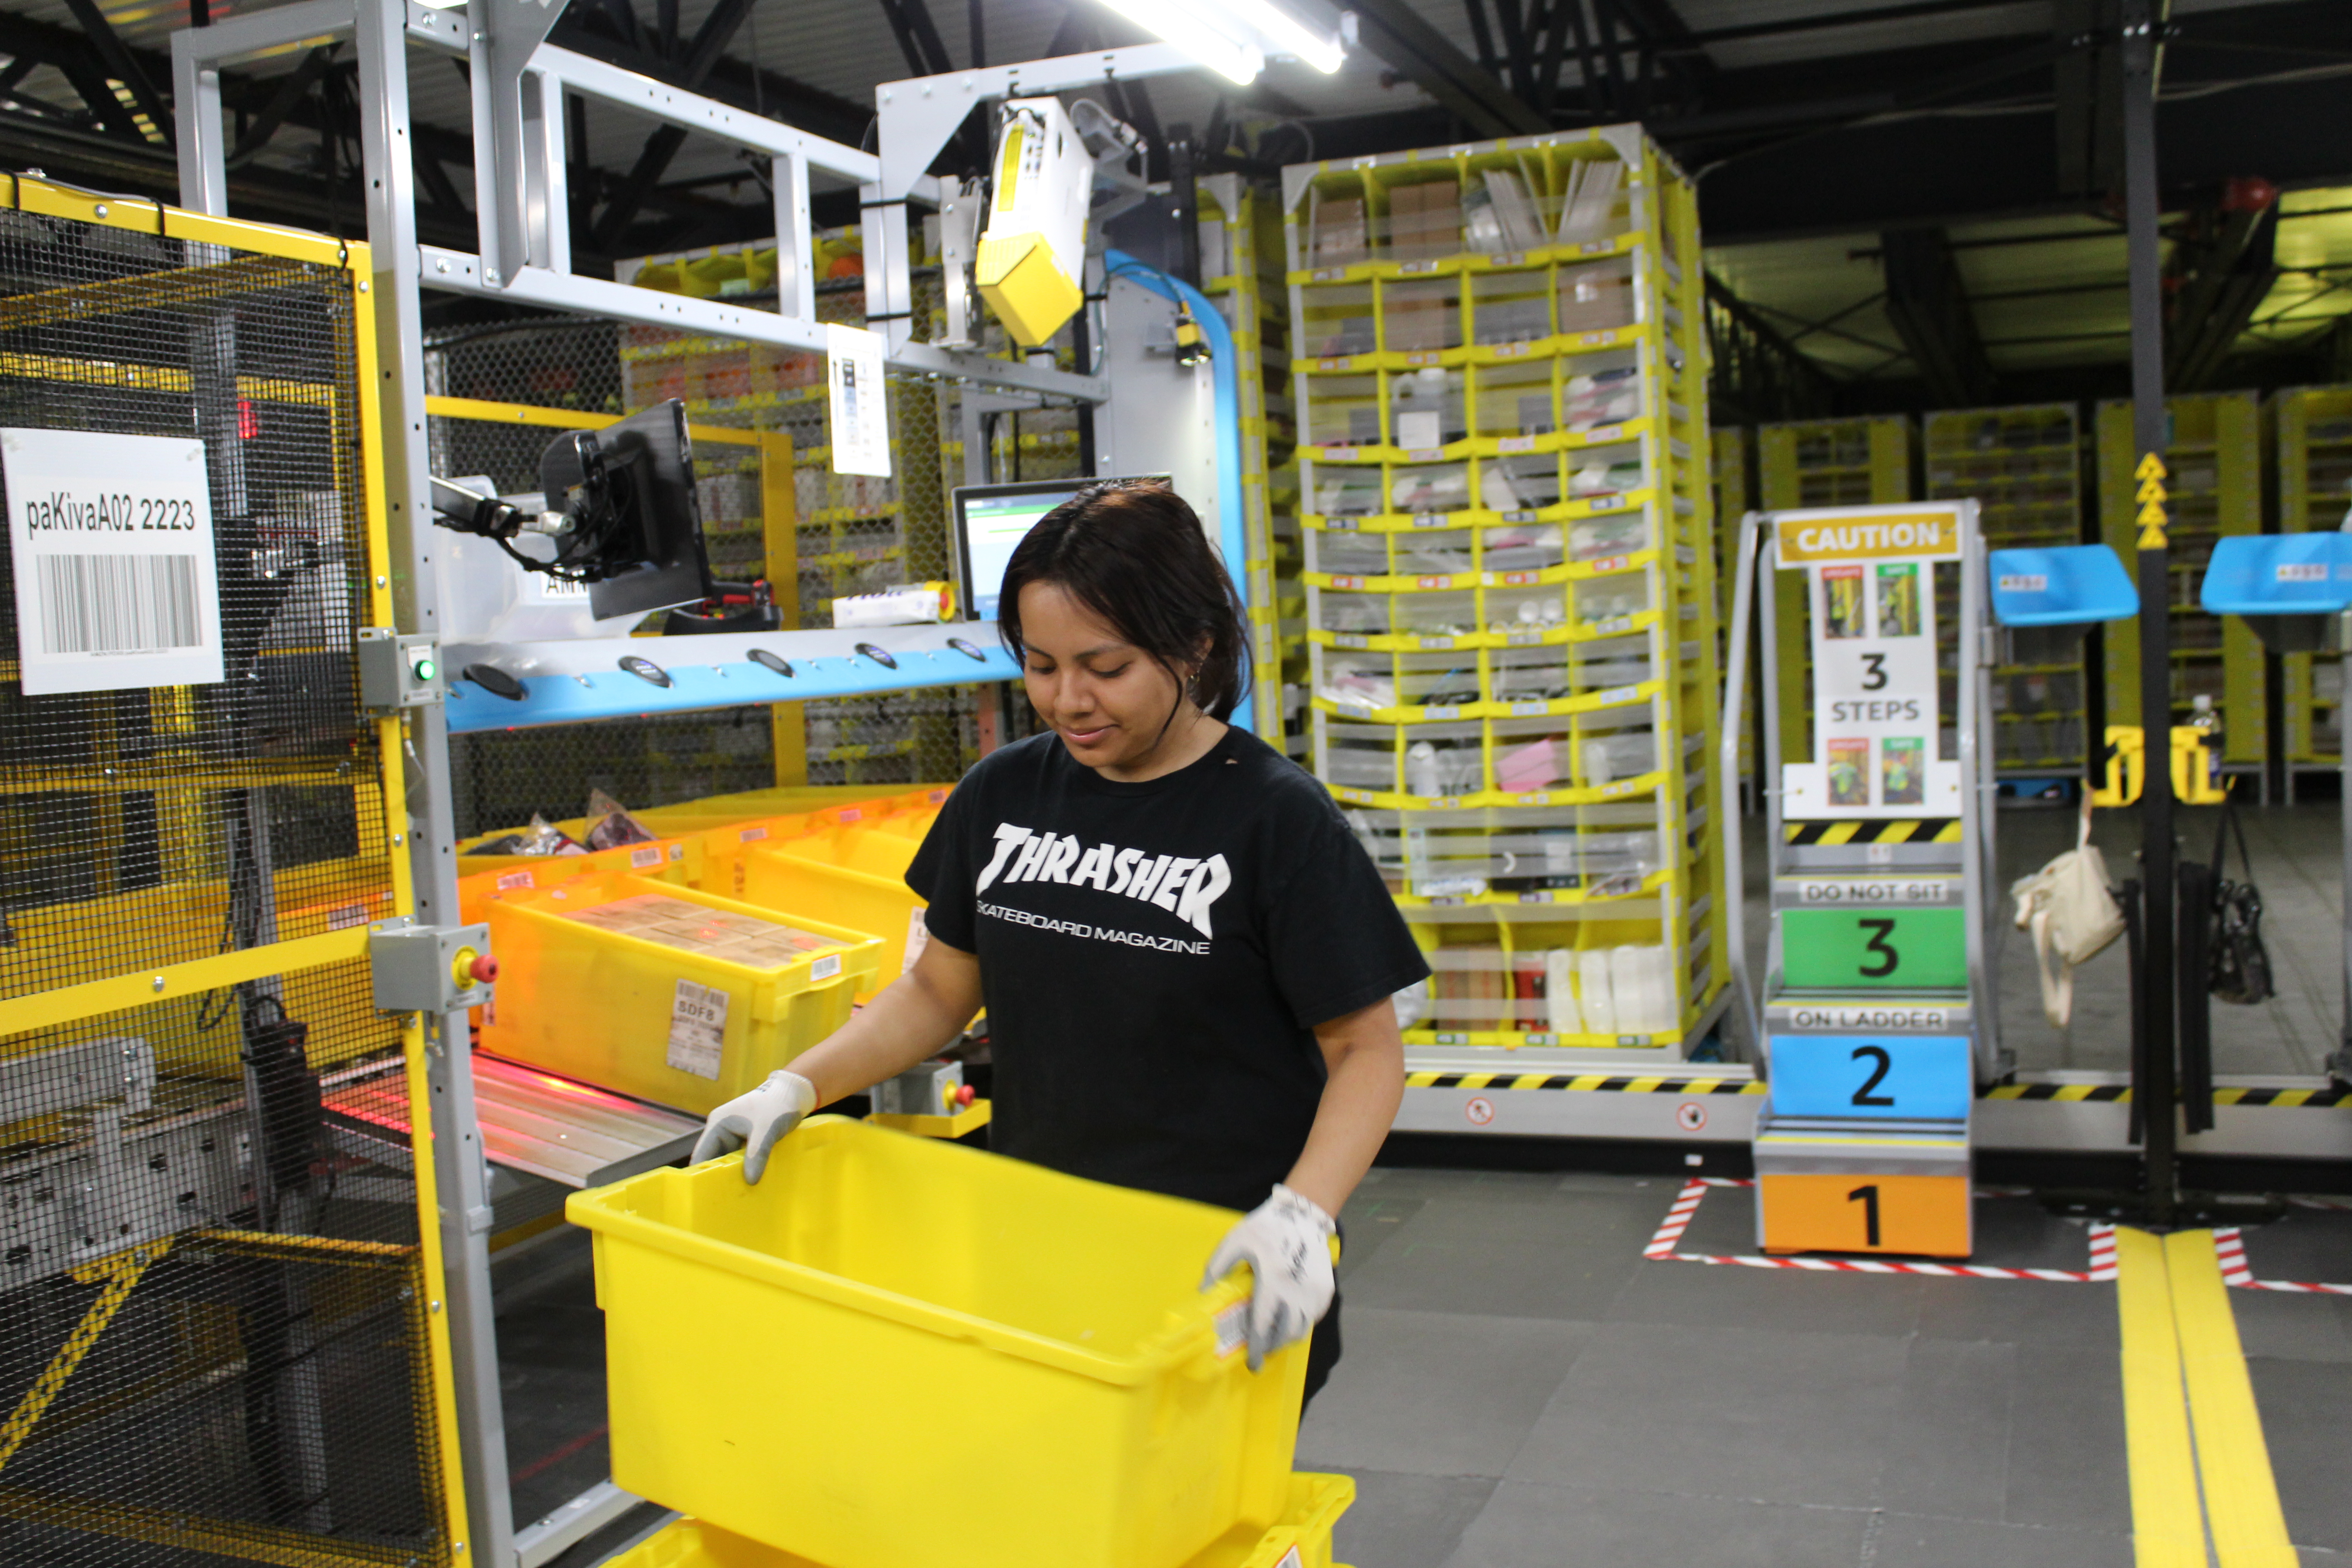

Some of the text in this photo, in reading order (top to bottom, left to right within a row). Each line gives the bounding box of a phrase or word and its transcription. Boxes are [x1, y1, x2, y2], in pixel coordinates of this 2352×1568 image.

[27, 491, 195, 540] paKivaA02 2223
[1797, 522, 1940, 552] CAUTION
[1860, 652, 1889, 691] 3
[1832, 700, 1920, 722] STEPS
[976, 822, 1231, 940] THRASHER
[1807, 884, 1943, 900] DO NOT SIT
[976, 900, 1210, 955] SKATEBOARD MAGAZINE
[1858, 918, 1899, 979] 3
[1796, 1011, 1942, 1027] ON LADDER
[1851, 1045, 1896, 1106] 2
[1847, 1185, 1881, 1247] 1
